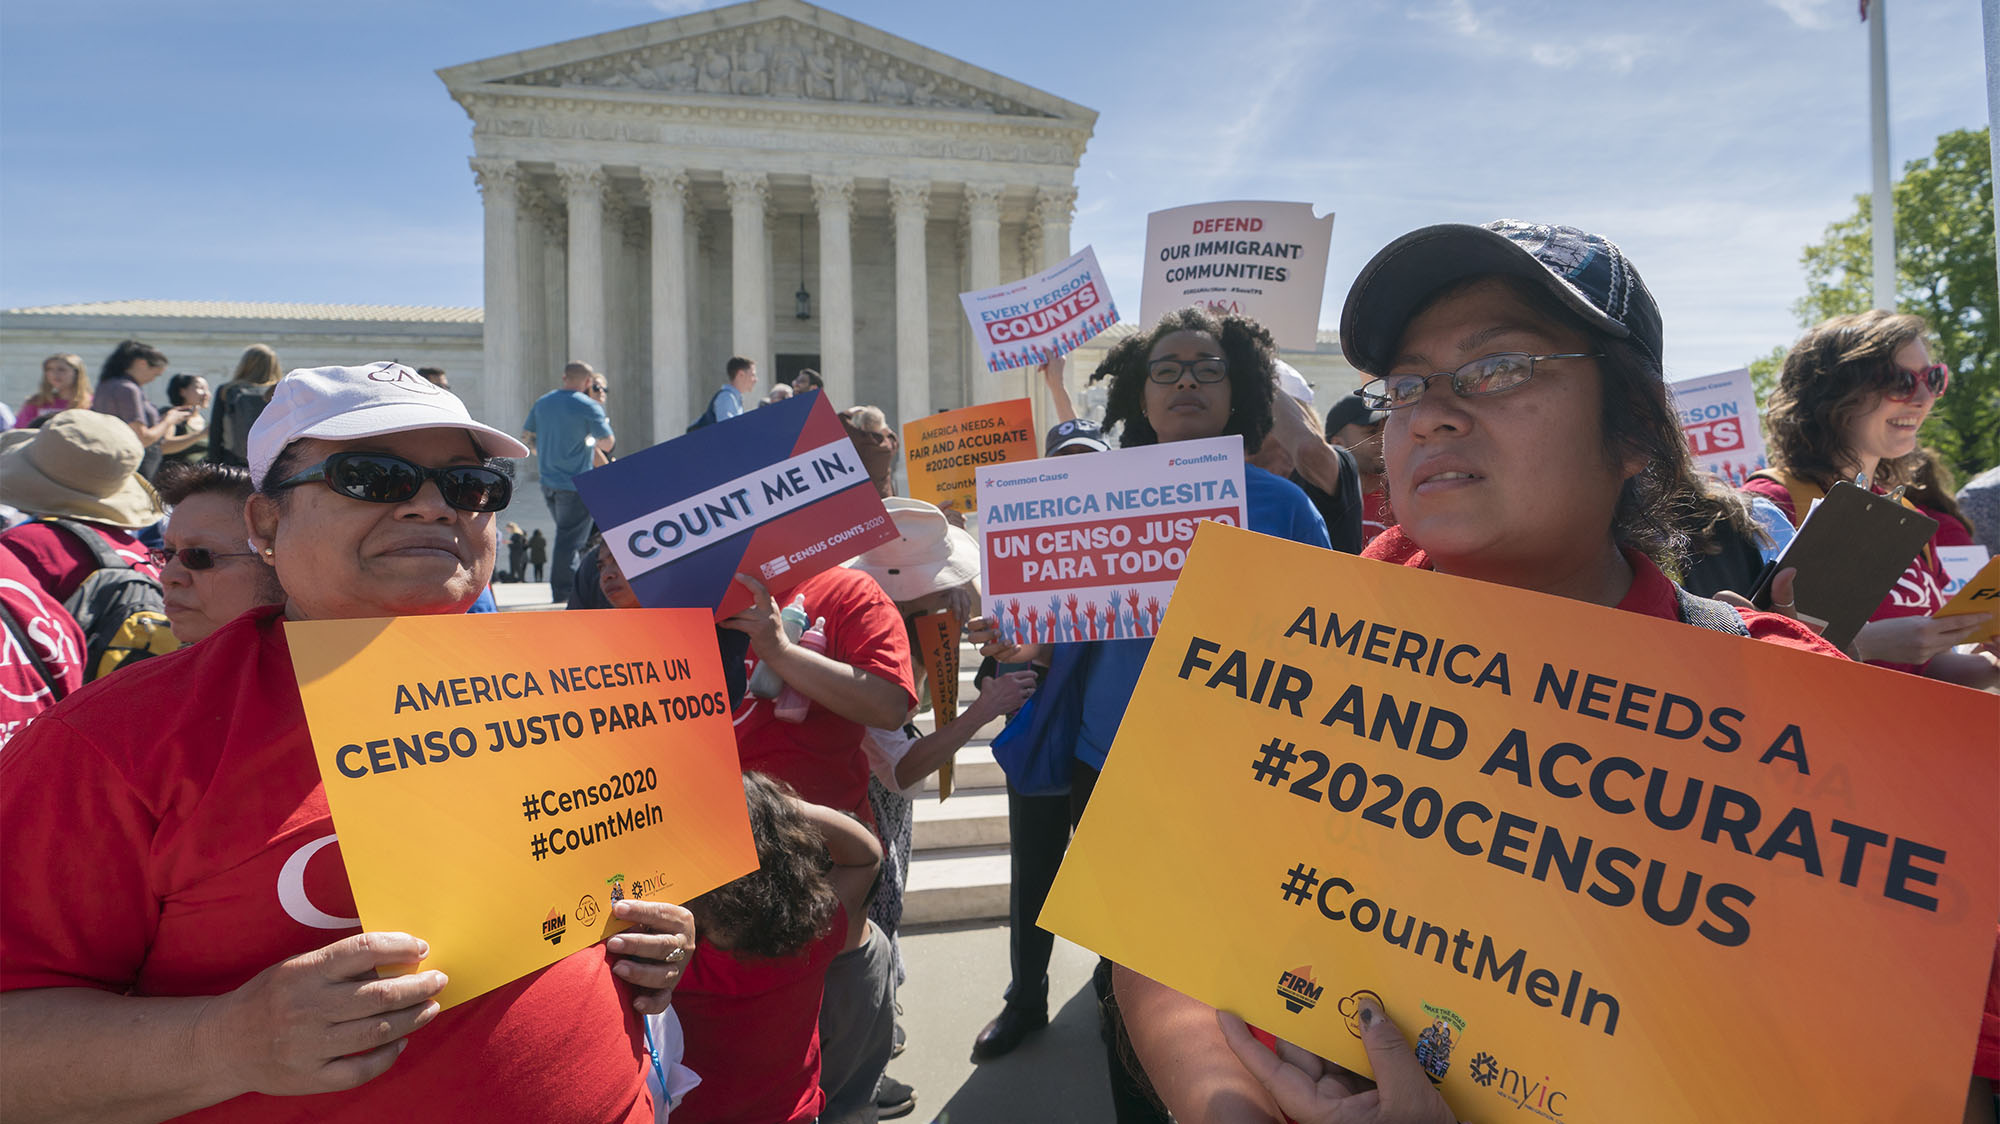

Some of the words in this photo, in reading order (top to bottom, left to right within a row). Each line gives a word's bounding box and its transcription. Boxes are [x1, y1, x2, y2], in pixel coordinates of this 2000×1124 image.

[1192, 217, 1263, 235] DEFEND
[1160, 244, 1190, 262] OUR
[1194, 240, 1303, 260] IMMIGRANT
[1166, 263, 1287, 283] COMMUNITIES
[980, 301, 1030, 322] EVERY
[1033, 271, 1092, 310] PERSON
[990, 286, 1096, 341] COUNTS
[921, 424, 959, 442] AMERICA
[961, 417, 995, 432] NEEDS
[997, 417, 1006, 427] A
[1689, 401, 1739, 423] SON
[909, 447, 930, 461] FAIR
[932, 441, 955, 455] AND
[957, 429, 1028, 449] ACCURATE
[925, 449, 1006, 473] #2020CENSUS
[1168, 453, 1228, 467] #CountMeIn
[936, 477, 976, 492] #CountM
[996, 476, 1038, 488] Common
[1039, 471, 1069, 483] Cause
[628, 488, 754, 560] COUNT
[761, 466, 810, 506] ME
[811, 452, 855, 484] IN.
[987, 494, 1100, 525] AMERICA
[1106, 478, 1239, 512] NECESITA
[788, 540, 828, 565] CENSUS
[828, 523, 865, 546] COUNTS
[865, 515, 886, 531] 2020
[993, 534, 1031, 559] UN
[1035, 525, 1132, 553] CENSO
[1022, 557, 1097, 583] PARA
[1102, 547, 1191, 576] TODO
[393, 671, 544, 714] AMERICA
[548, 661, 660, 694] NECESITA
[663, 658, 691, 682] UN
[936, 660, 946, 704] NEEDS
[1283, 606, 1512, 697] AMERICA
[1533, 662, 1746, 753] NEEDS
[1758, 724, 1811, 776] A
[335, 726, 478, 779] CENSO
[484, 711, 584, 753] JUSTO
[588, 701, 658, 735] PARA
[658, 691, 726, 722] TODOS
[1178, 636, 1313, 718] FAIR
[1320, 683, 1468, 761] AND
[1479, 728, 1947, 913] ACCURATE
[522, 766, 658, 822] #Censo2020
[530, 803, 664, 861] #CountMeIn
[1251, 737, 1756, 947] #2020CENSUS
[642, 870, 668, 896] nyic
[542, 914, 566, 934] FIRM
[575, 901, 600, 921] CASA
[1280, 862, 1620, 1037] #CountMeIn
[1277, 970, 1324, 1001] FIRM
[1424, 1004, 1439, 1013] MAKE
[1451, 1013, 1466, 1028] ROAD
[1499, 1067, 1568, 1117] nyic
